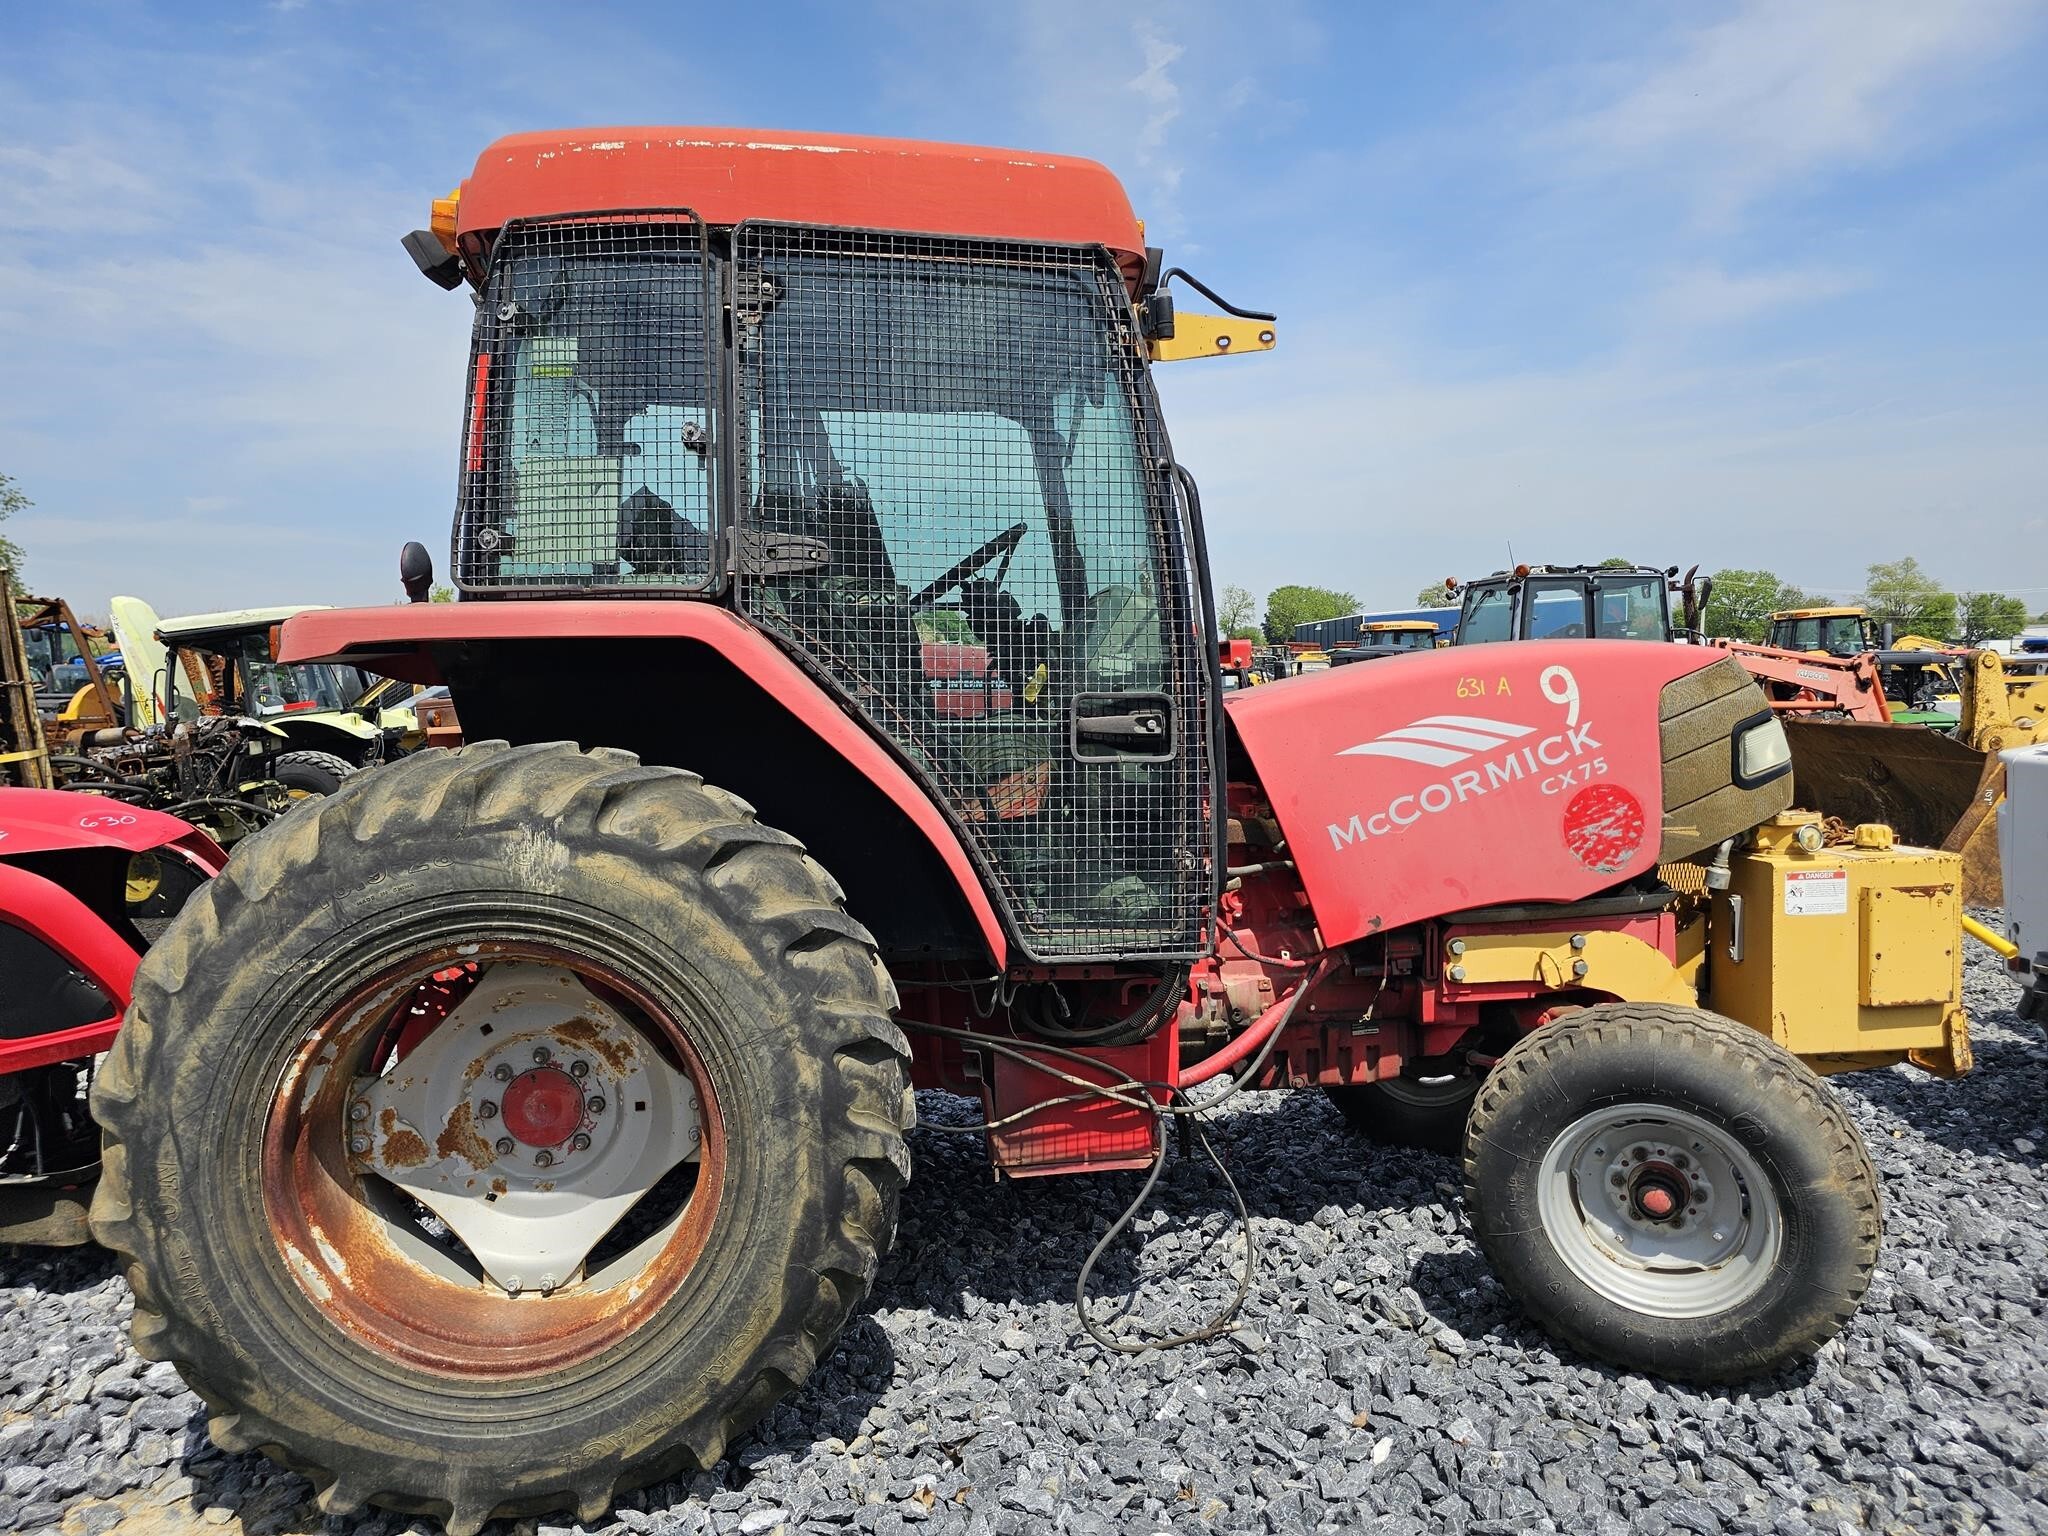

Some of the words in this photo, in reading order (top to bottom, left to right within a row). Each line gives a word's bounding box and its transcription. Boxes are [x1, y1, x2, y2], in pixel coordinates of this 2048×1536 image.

[1456, 677, 1486, 698] 631
[1496, 676, 1512, 697] A
[1538, 664, 1581, 728] 9
[1326, 720, 1603, 851] McCORMICK
[79, 814, 137, 829] 630
[1804, 871, 1834, 880] DANGER
